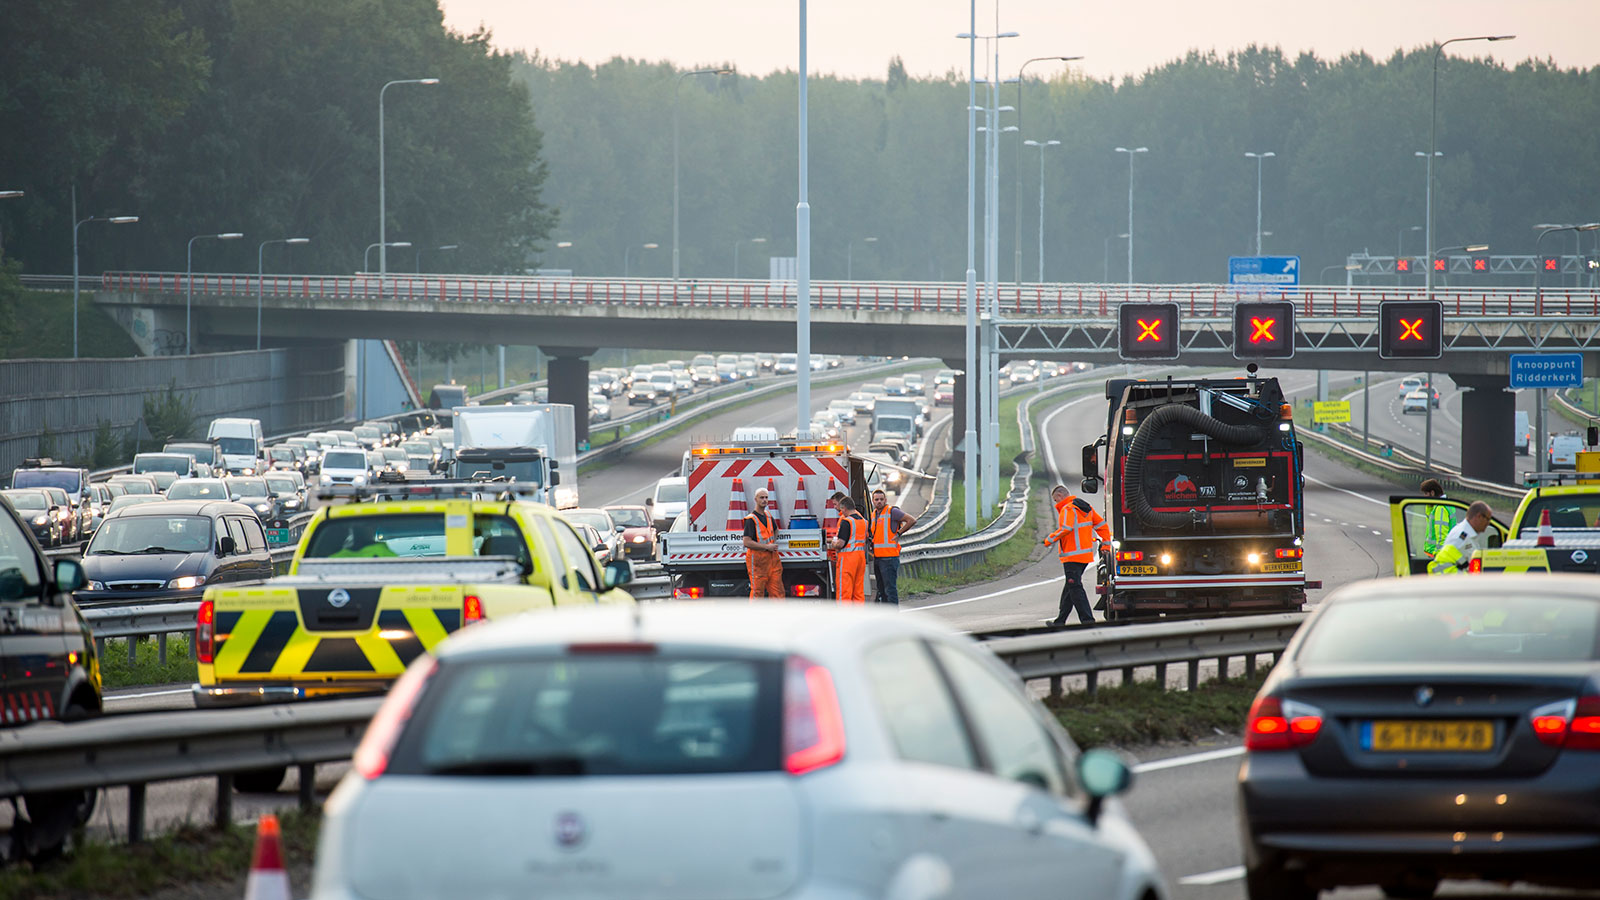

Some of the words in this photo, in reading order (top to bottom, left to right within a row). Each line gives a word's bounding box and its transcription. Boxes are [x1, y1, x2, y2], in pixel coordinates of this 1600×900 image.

[1517, 360, 1576, 371] knooppunt
[1516, 373, 1577, 382] Ridderkerk
[698, 534, 728, 542] Incident
